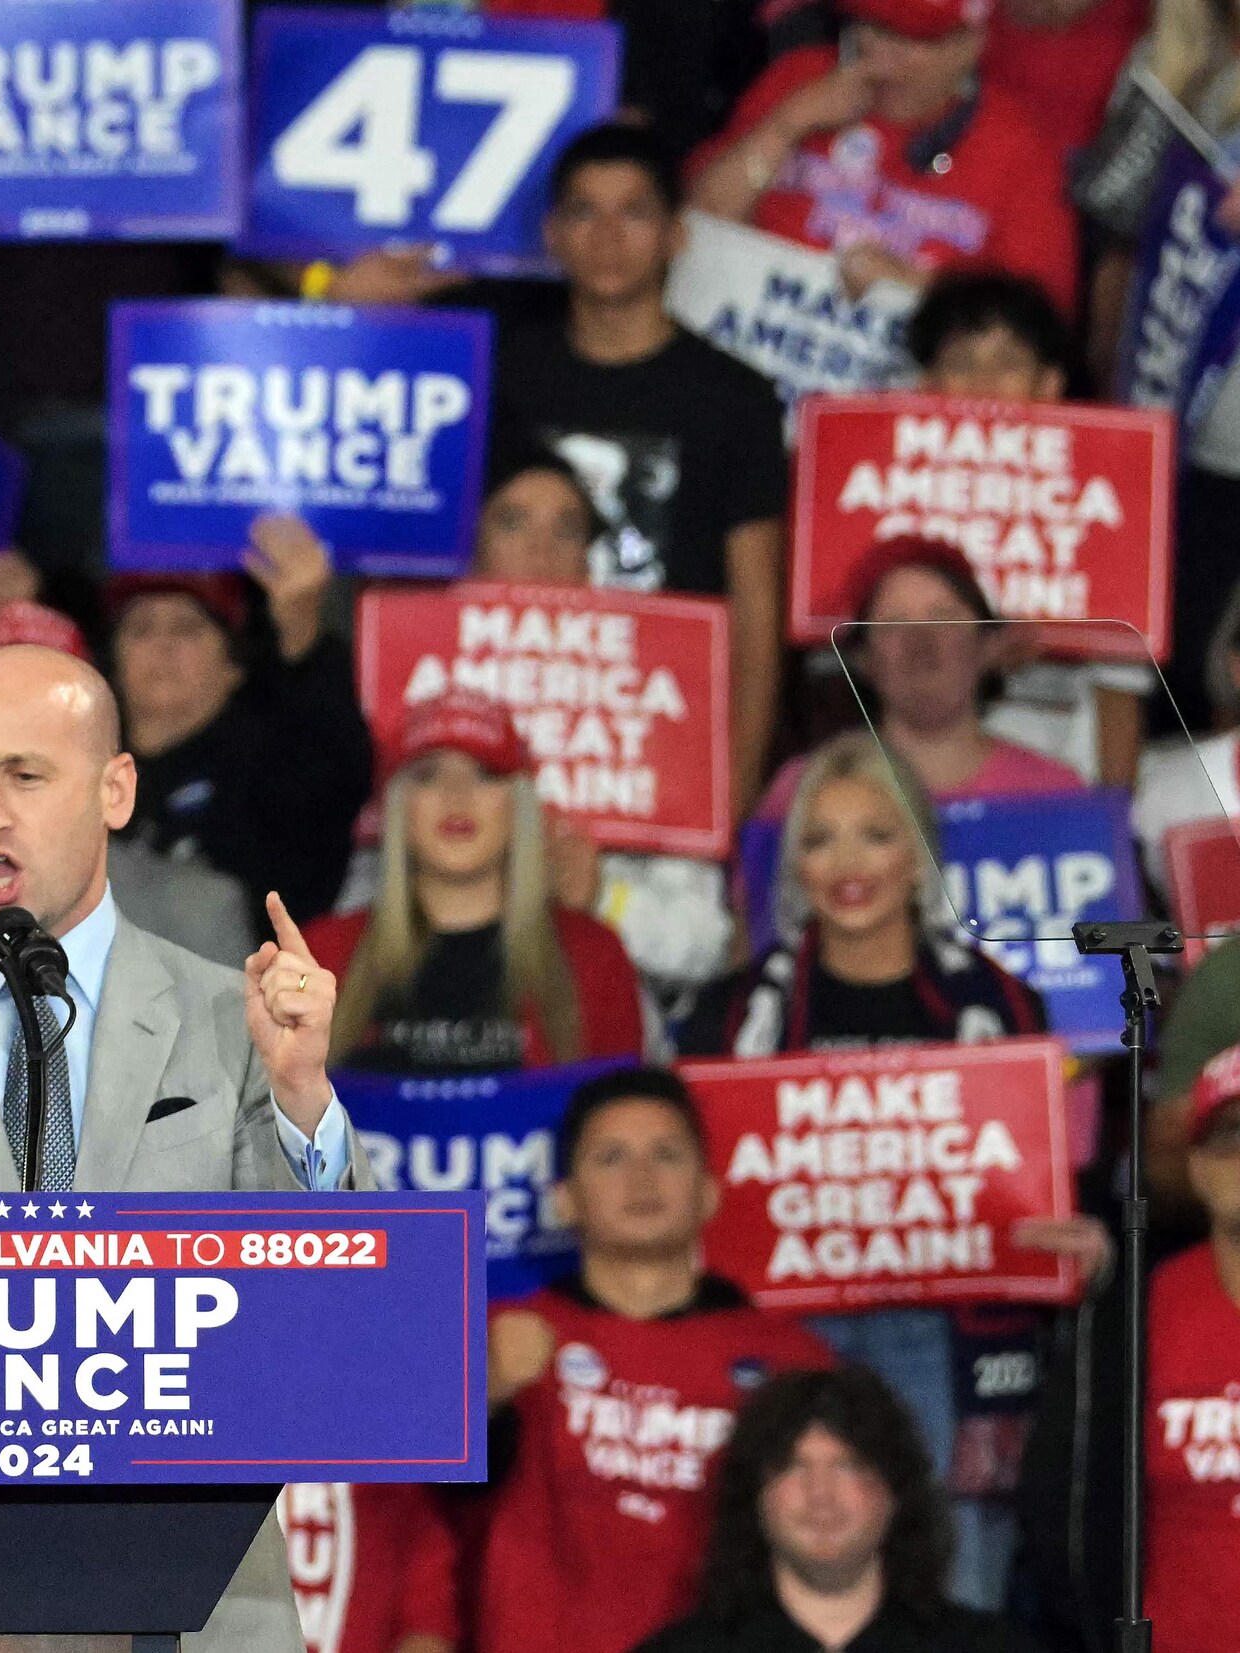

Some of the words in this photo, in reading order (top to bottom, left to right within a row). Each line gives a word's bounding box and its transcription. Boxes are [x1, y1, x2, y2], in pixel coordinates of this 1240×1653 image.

[271, 45, 578, 231] 47
[129, 364, 471, 433] TRUMP
[170, 427, 433, 489] VANCE
[893, 417, 1073, 467] MAKE
[838, 460, 1124, 528] AMERICA
[459, 603, 637, 664] MAKE
[402, 654, 690, 722] AMERICA
[511, 702, 653, 765] EAT
[535, 762, 659, 818] AIN!
[775, 1070, 963, 1128] MAKE
[727, 1120, 1022, 1186] AMERICA
[767, 1175, 985, 1229] GREAT
[166, 1233, 225, 1266] TO
[239, 1232, 377, 1266] 88022
[766, 1222, 994, 1282] AGAIN!
[41, 1419, 120, 1437] GREAT
[128, 1419, 214, 1436] AGAIN!
